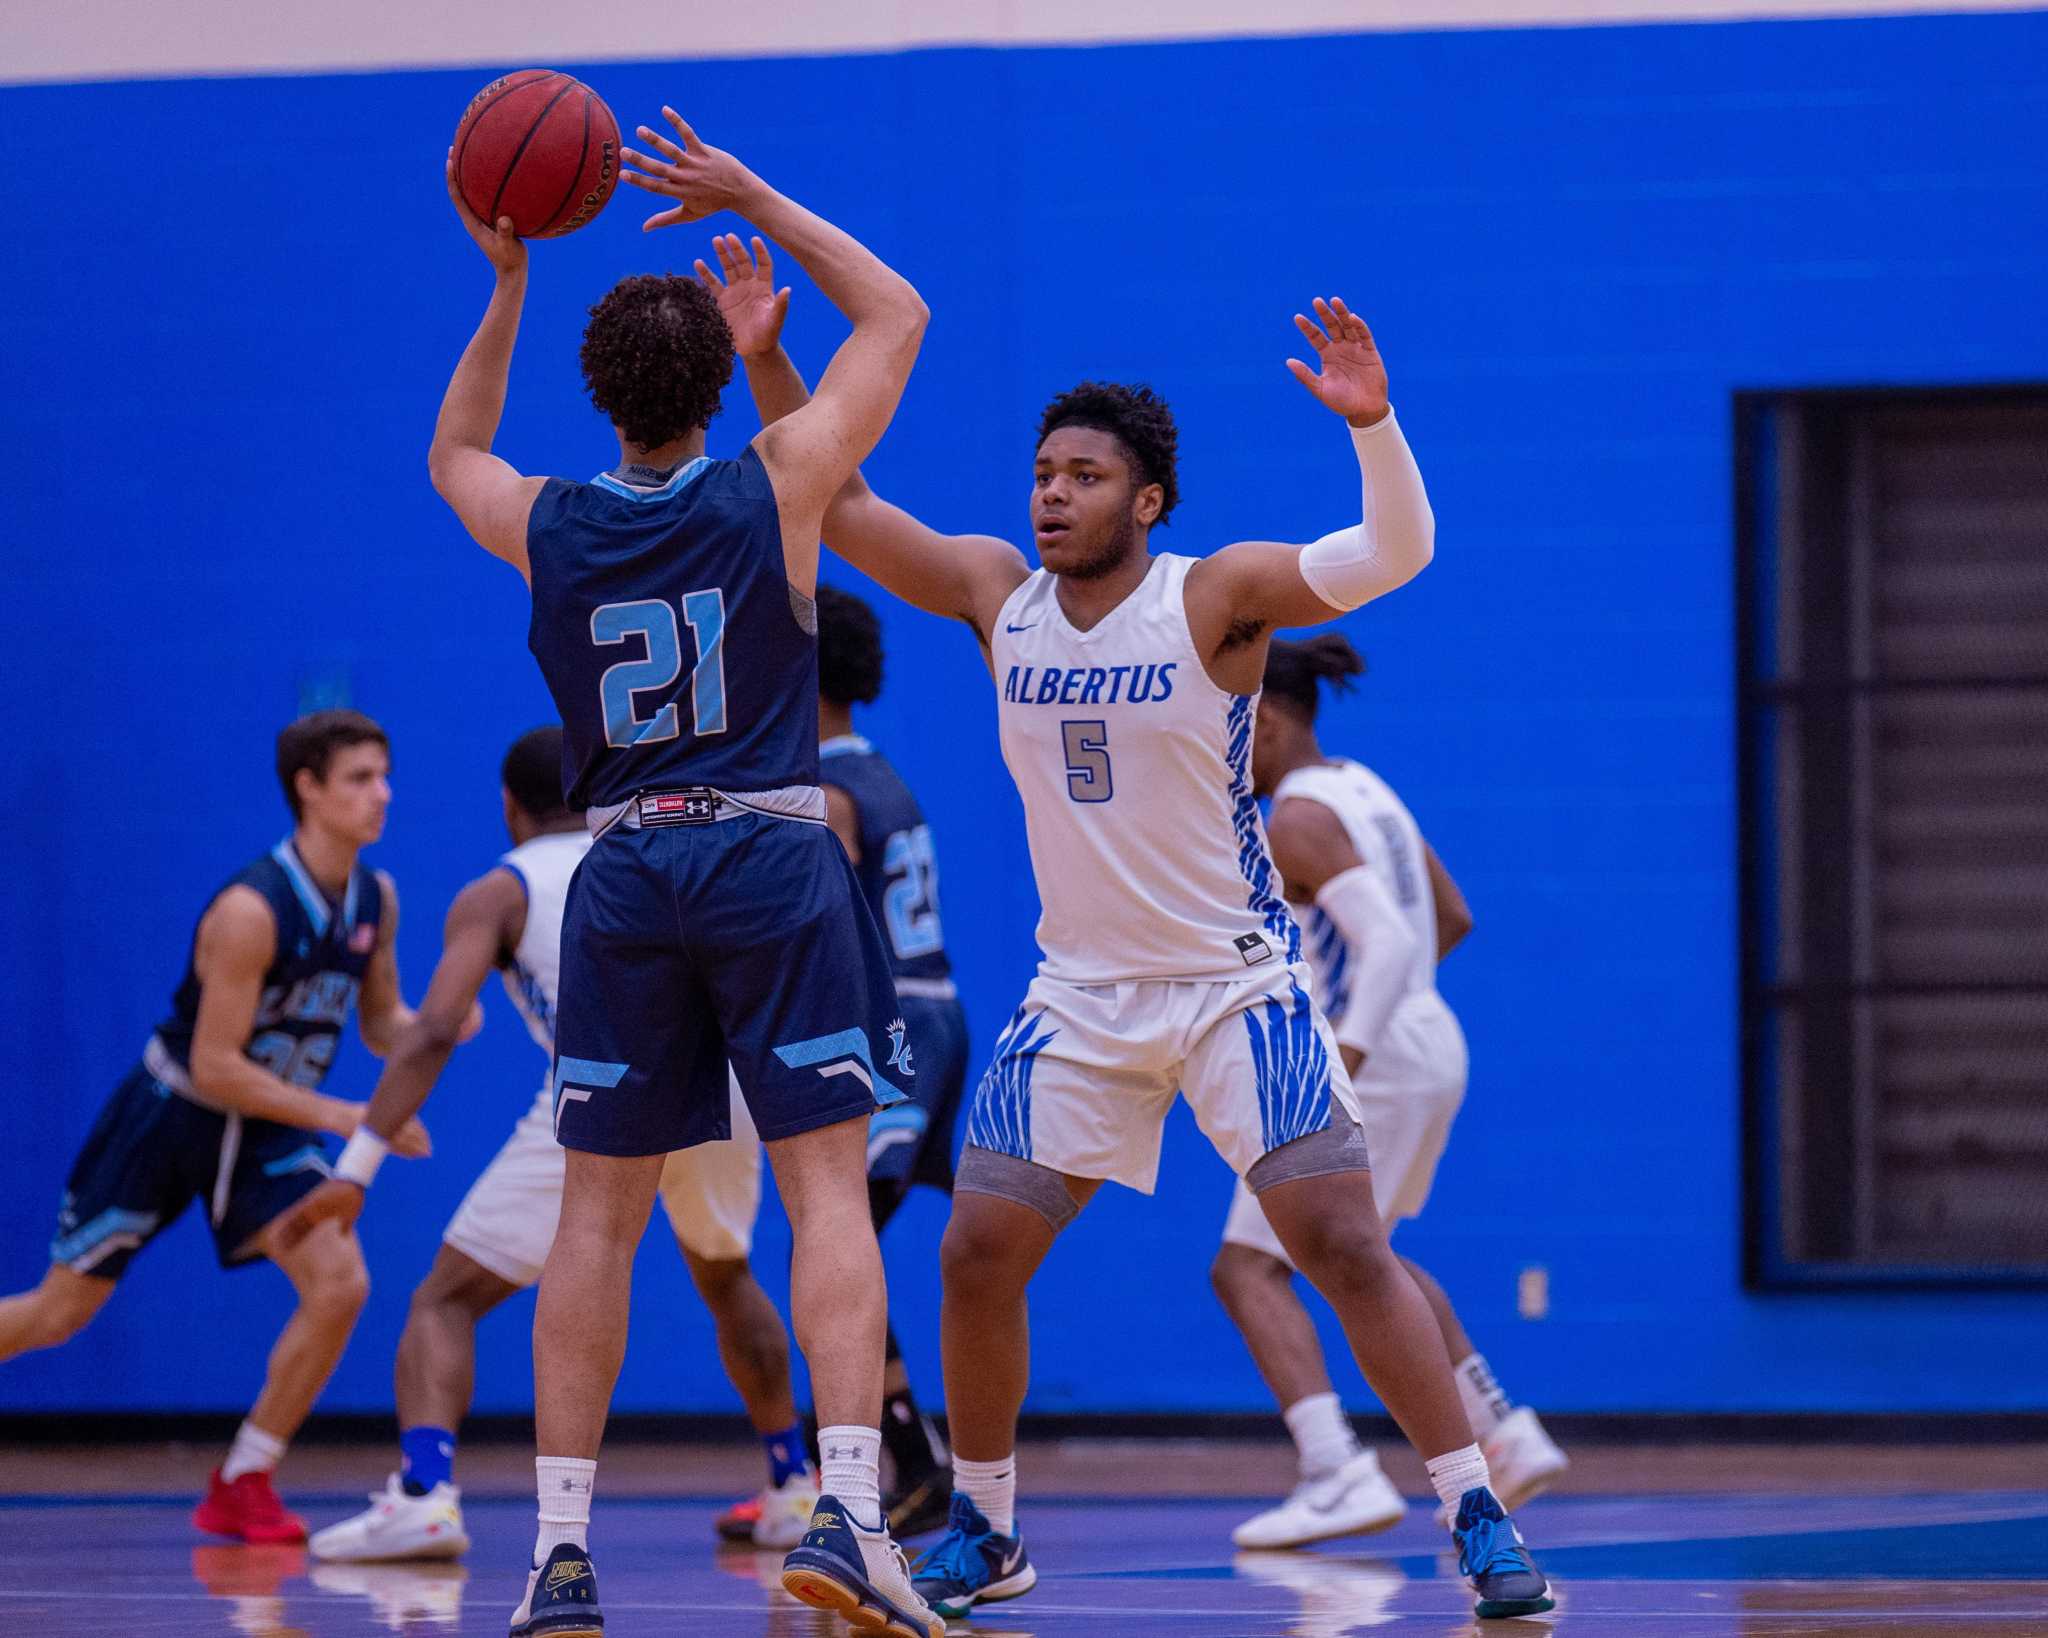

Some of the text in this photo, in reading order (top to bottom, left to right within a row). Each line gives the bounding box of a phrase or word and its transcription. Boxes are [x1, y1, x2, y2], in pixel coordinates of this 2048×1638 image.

[590, 588, 727, 748] 21
[1004, 663, 1177, 705] ALBERTUS
[1061, 720, 1113, 803] 5
[1243, 938, 1256, 947] L
[551, 1589, 588, 1601] AIR
